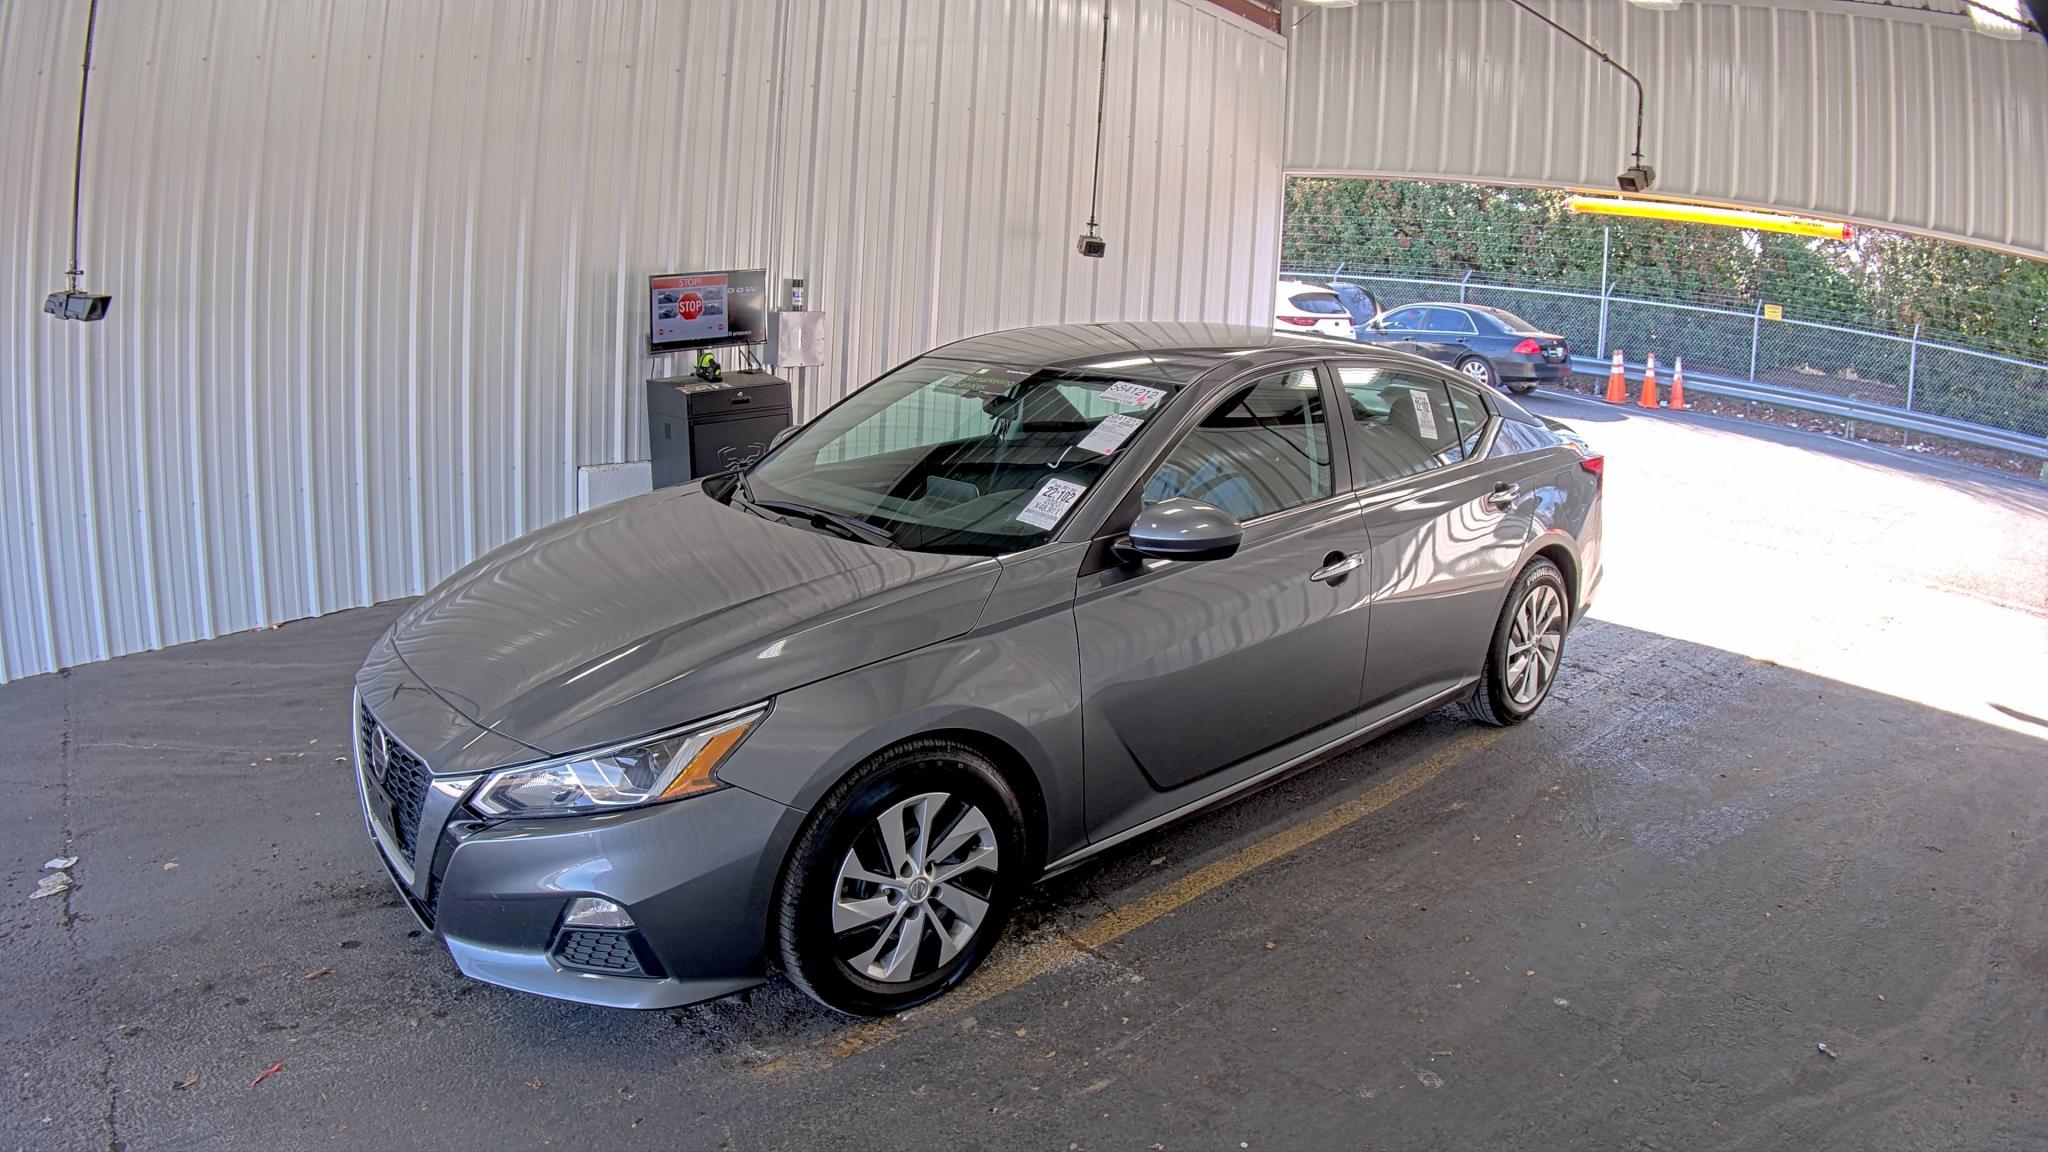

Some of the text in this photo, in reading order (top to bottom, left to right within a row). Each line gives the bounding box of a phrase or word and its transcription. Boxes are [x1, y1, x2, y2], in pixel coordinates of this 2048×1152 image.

[679, 277, 702, 287] STOP!
[679, 300, 702, 313] STOP
[1110, 382, 1159, 400] 5841212
